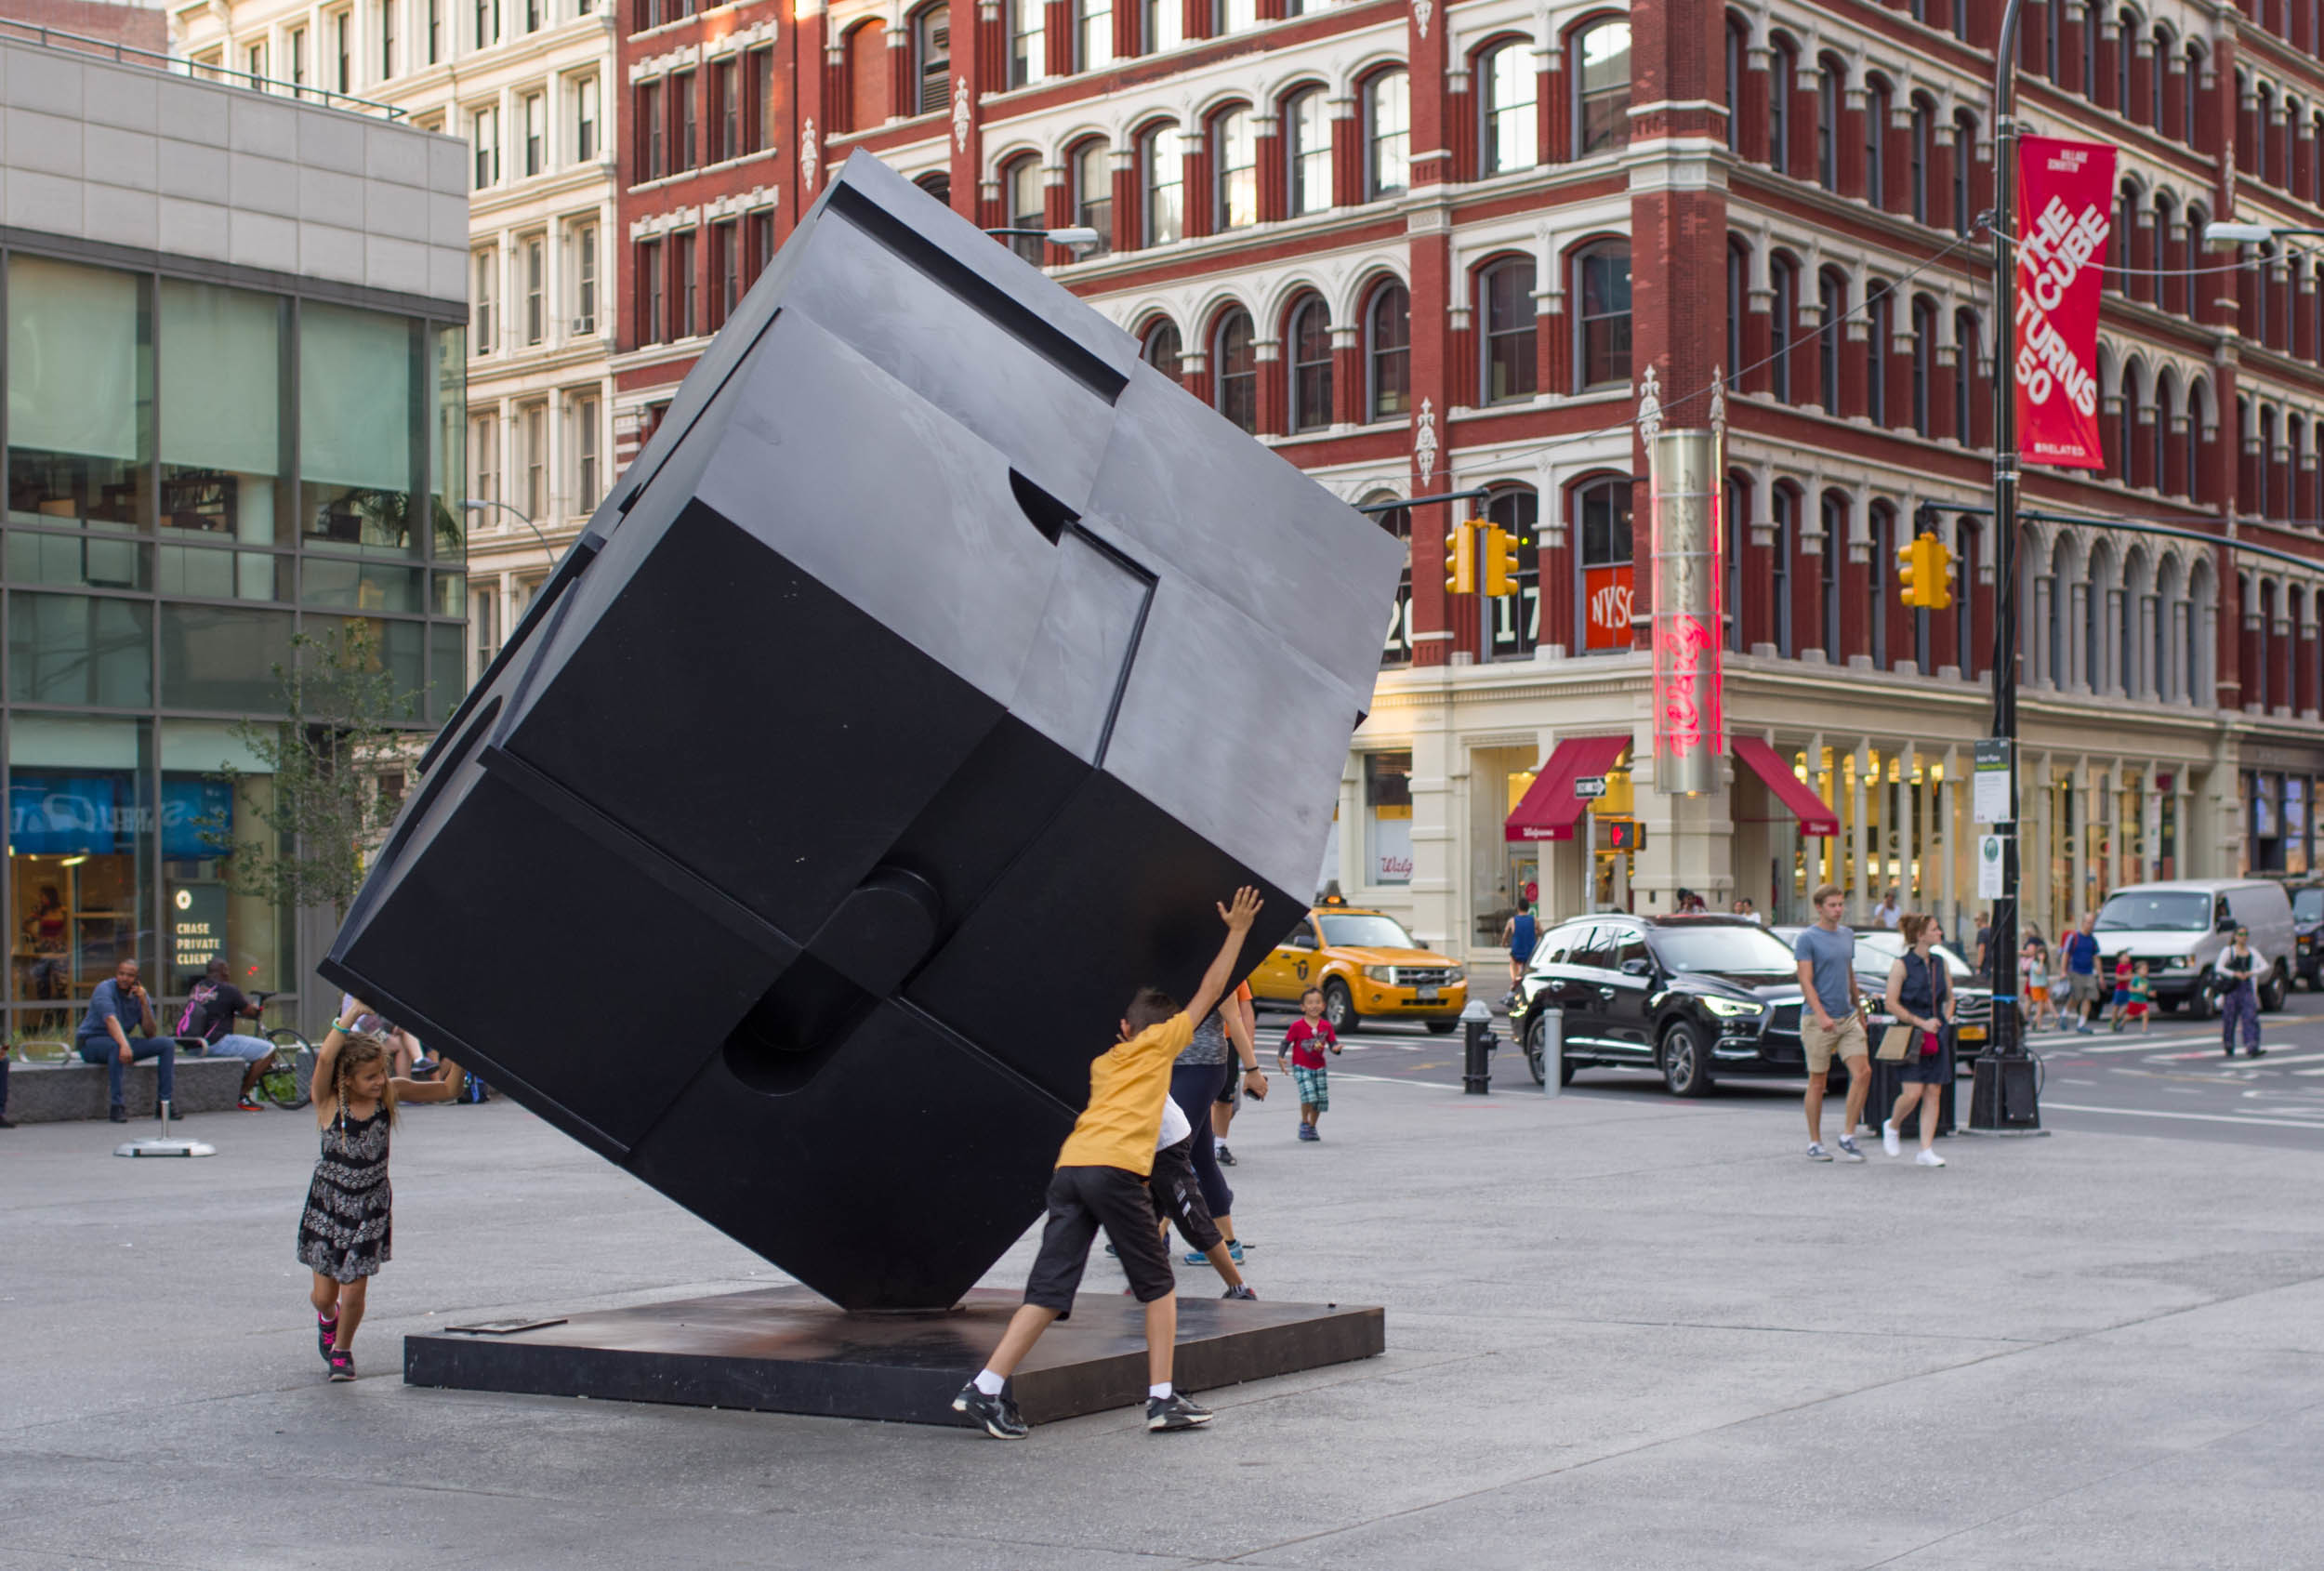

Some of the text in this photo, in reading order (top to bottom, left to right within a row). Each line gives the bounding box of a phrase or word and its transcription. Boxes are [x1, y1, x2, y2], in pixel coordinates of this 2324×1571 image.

[2016, 195, 2074, 276] THE
[2035, 204, 2110, 310] CUBE
[2015, 288, 2098, 416] TURNS
[2015, 345, 2052, 404] 50
[177, 923, 210, 934] CHASE
[177, 939, 219, 949] PRIVATE
[177, 954, 213, 964] CLIENT
